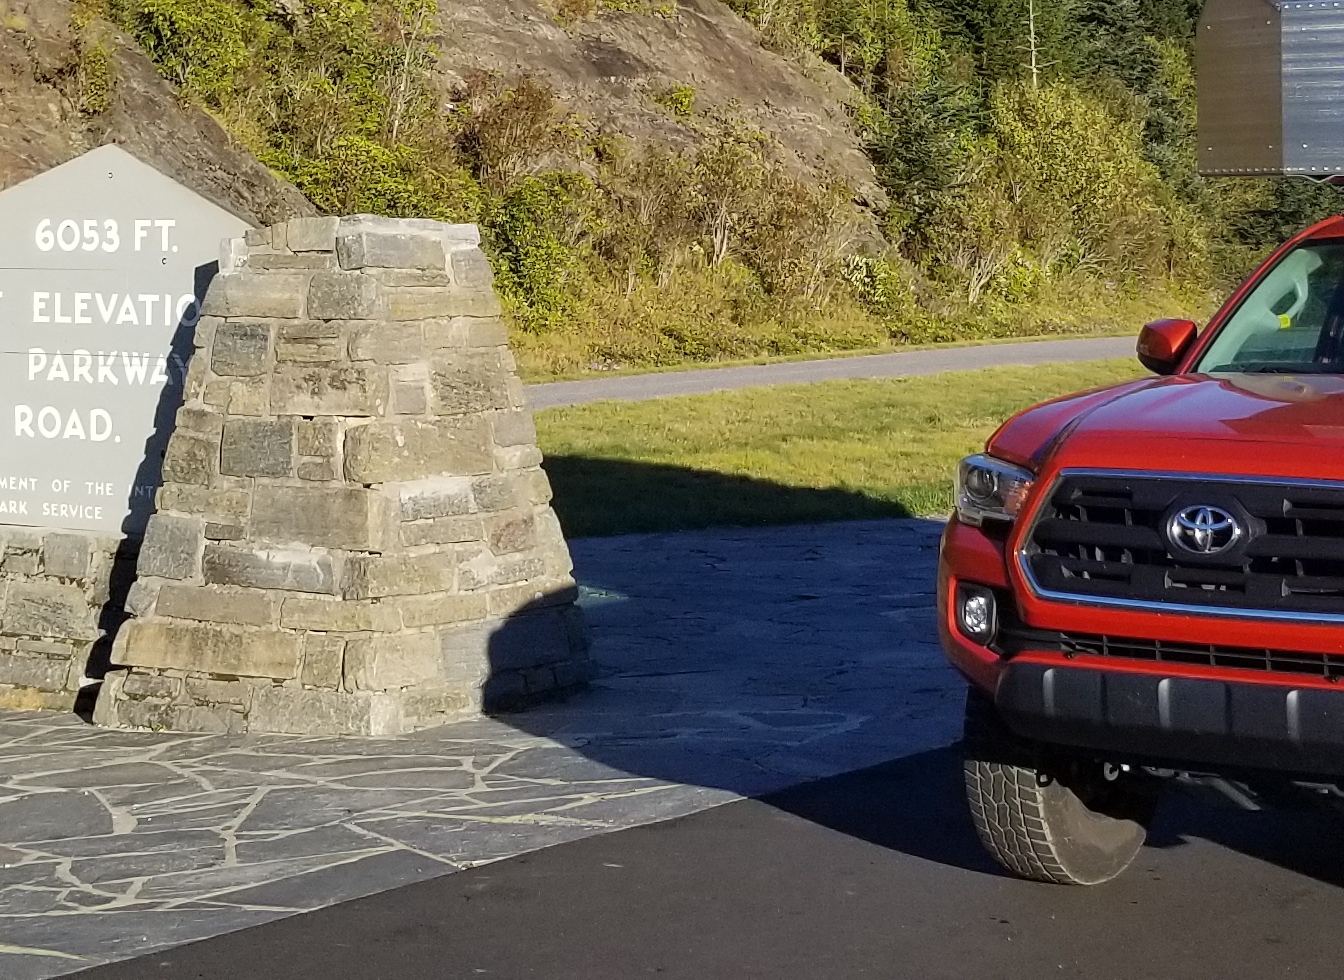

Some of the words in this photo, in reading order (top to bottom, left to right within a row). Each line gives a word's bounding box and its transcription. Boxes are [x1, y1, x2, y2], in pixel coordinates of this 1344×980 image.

[35, 219, 120, 253] 6053
[134, 219, 178, 253] FT.
[33, 291, 200, 327] ELEVATIO
[28, 347, 191, 386] PARKWAY
[14, 404, 121, 443] ROAD.
[51, 478, 71, 493] OF
[85, 481, 114, 496] THE
[128, 484, 154, 499] INT
[42, 502, 103, 520] SERVICE
